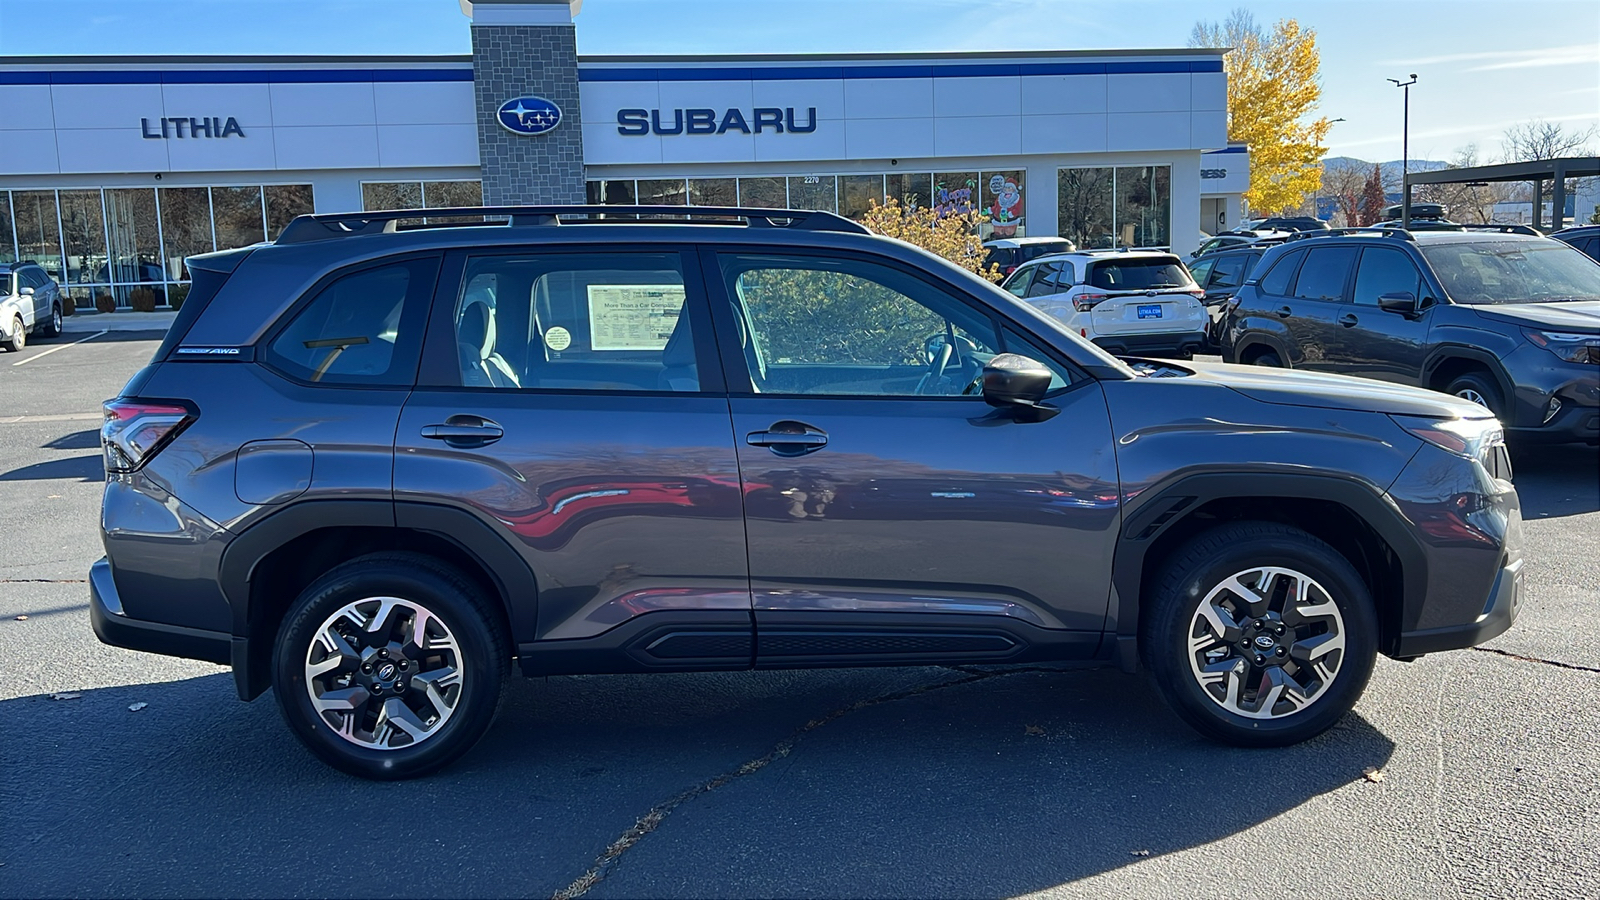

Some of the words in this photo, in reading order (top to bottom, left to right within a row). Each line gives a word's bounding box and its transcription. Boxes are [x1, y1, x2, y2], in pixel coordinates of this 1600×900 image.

[140, 116, 246, 139] LITHIA
[617, 107, 817, 136] SUBARU
[804, 176, 820, 184] 2270
[287, 588, 338, 641] YOKOHAMA
